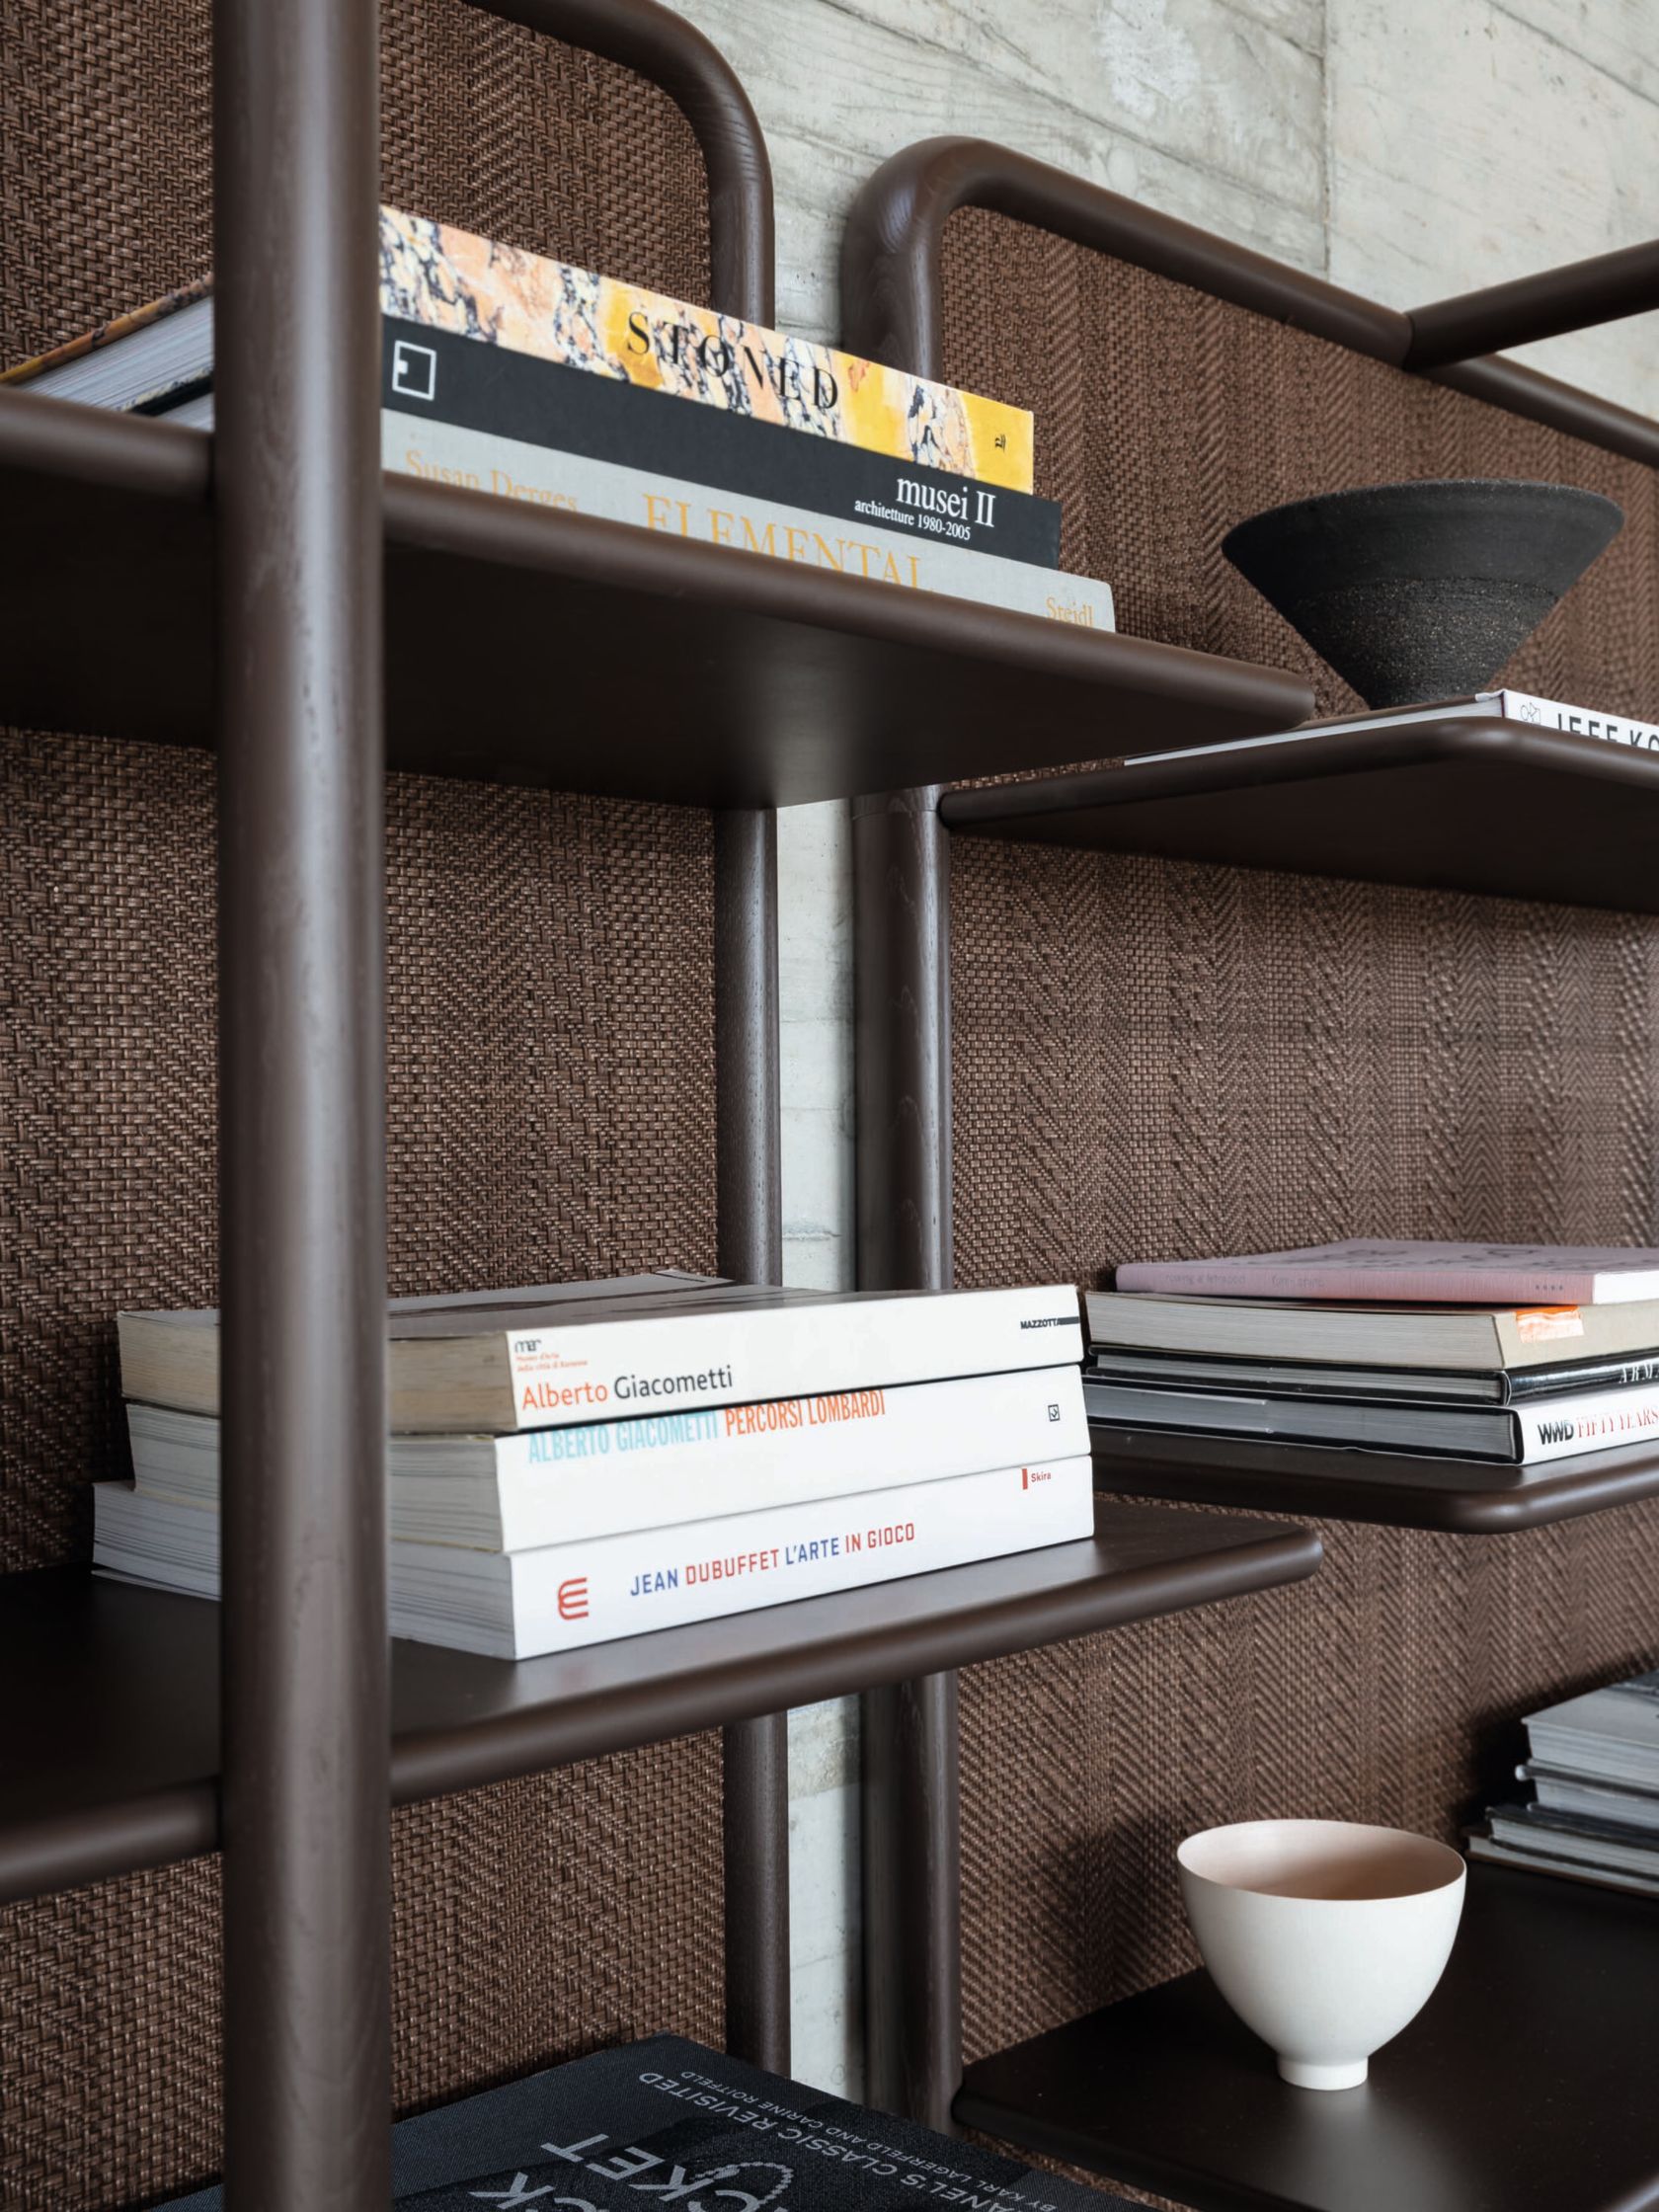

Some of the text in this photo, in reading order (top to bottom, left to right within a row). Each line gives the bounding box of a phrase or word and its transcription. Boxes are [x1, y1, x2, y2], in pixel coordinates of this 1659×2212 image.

[628, 312, 837, 409] STONED
[854, 500, 971, 540] architetture 1980-2005
[896, 478, 996, 527] musei II
[521, 1365, 733, 1410] Alberto Giacometti
[529, 1390, 886, 1463] ALBERTO GIACOMETTI PERCORSI LOMBARDI
[1538, 1420, 1574, 1445] WWD
[1031, 1470, 1052, 1483] Skira
[630, 1523, 915, 1596] JEAN DUBUFFET L'ARTE IN GIOCO
[639, 2073, 779, 2130] REVISITED
[681, 2072, 1058, 2212] BY KARL LAGERFELD AND CARINE ROITFELD
[778, 2128, 897, 2174] CLASSIC
